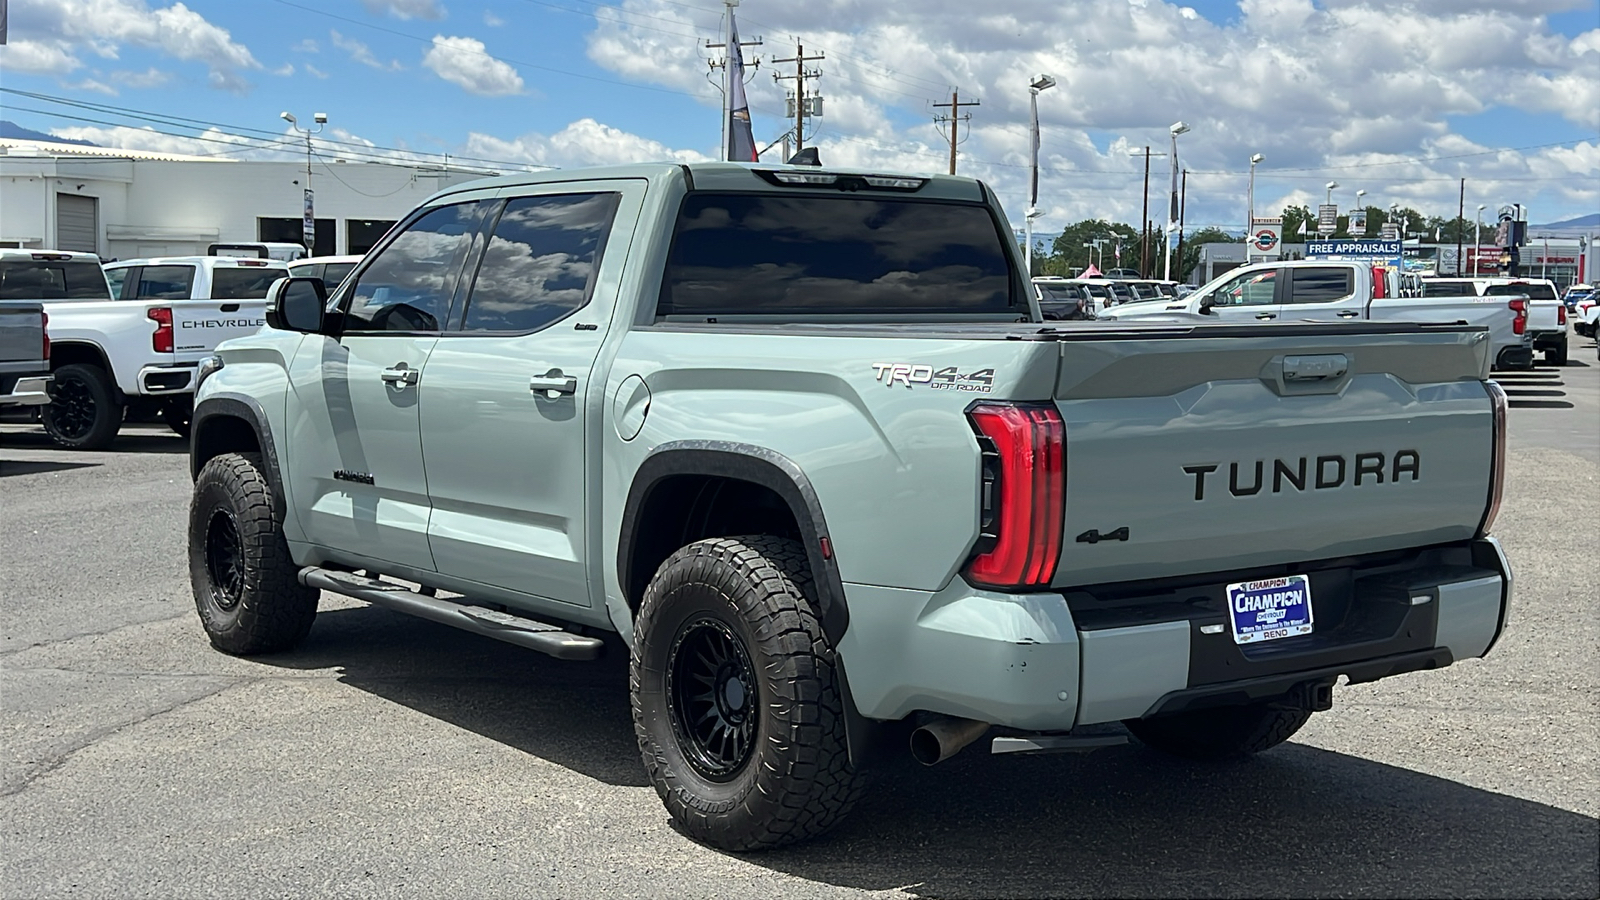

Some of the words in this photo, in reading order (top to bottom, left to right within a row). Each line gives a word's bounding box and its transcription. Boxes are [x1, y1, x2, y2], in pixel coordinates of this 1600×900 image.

[1309, 244, 1333, 254] FREE
[1335, 243, 1400, 254] APPRAISALS!
[182, 318, 267, 329] CHEVROLE
[872, 362, 934, 389] TRD
[931, 382, 955, 391] OFF
[956, 384, 993, 394] ROAD
[1182, 449, 1420, 501] TUNDRA
[1249, 579, 1286, 590] CHAMPION
[1235, 589, 1302, 613] CHAMPION
[1257, 610, 1284, 620] CHEVROLET
[1263, 629, 1288, 639] RENO
